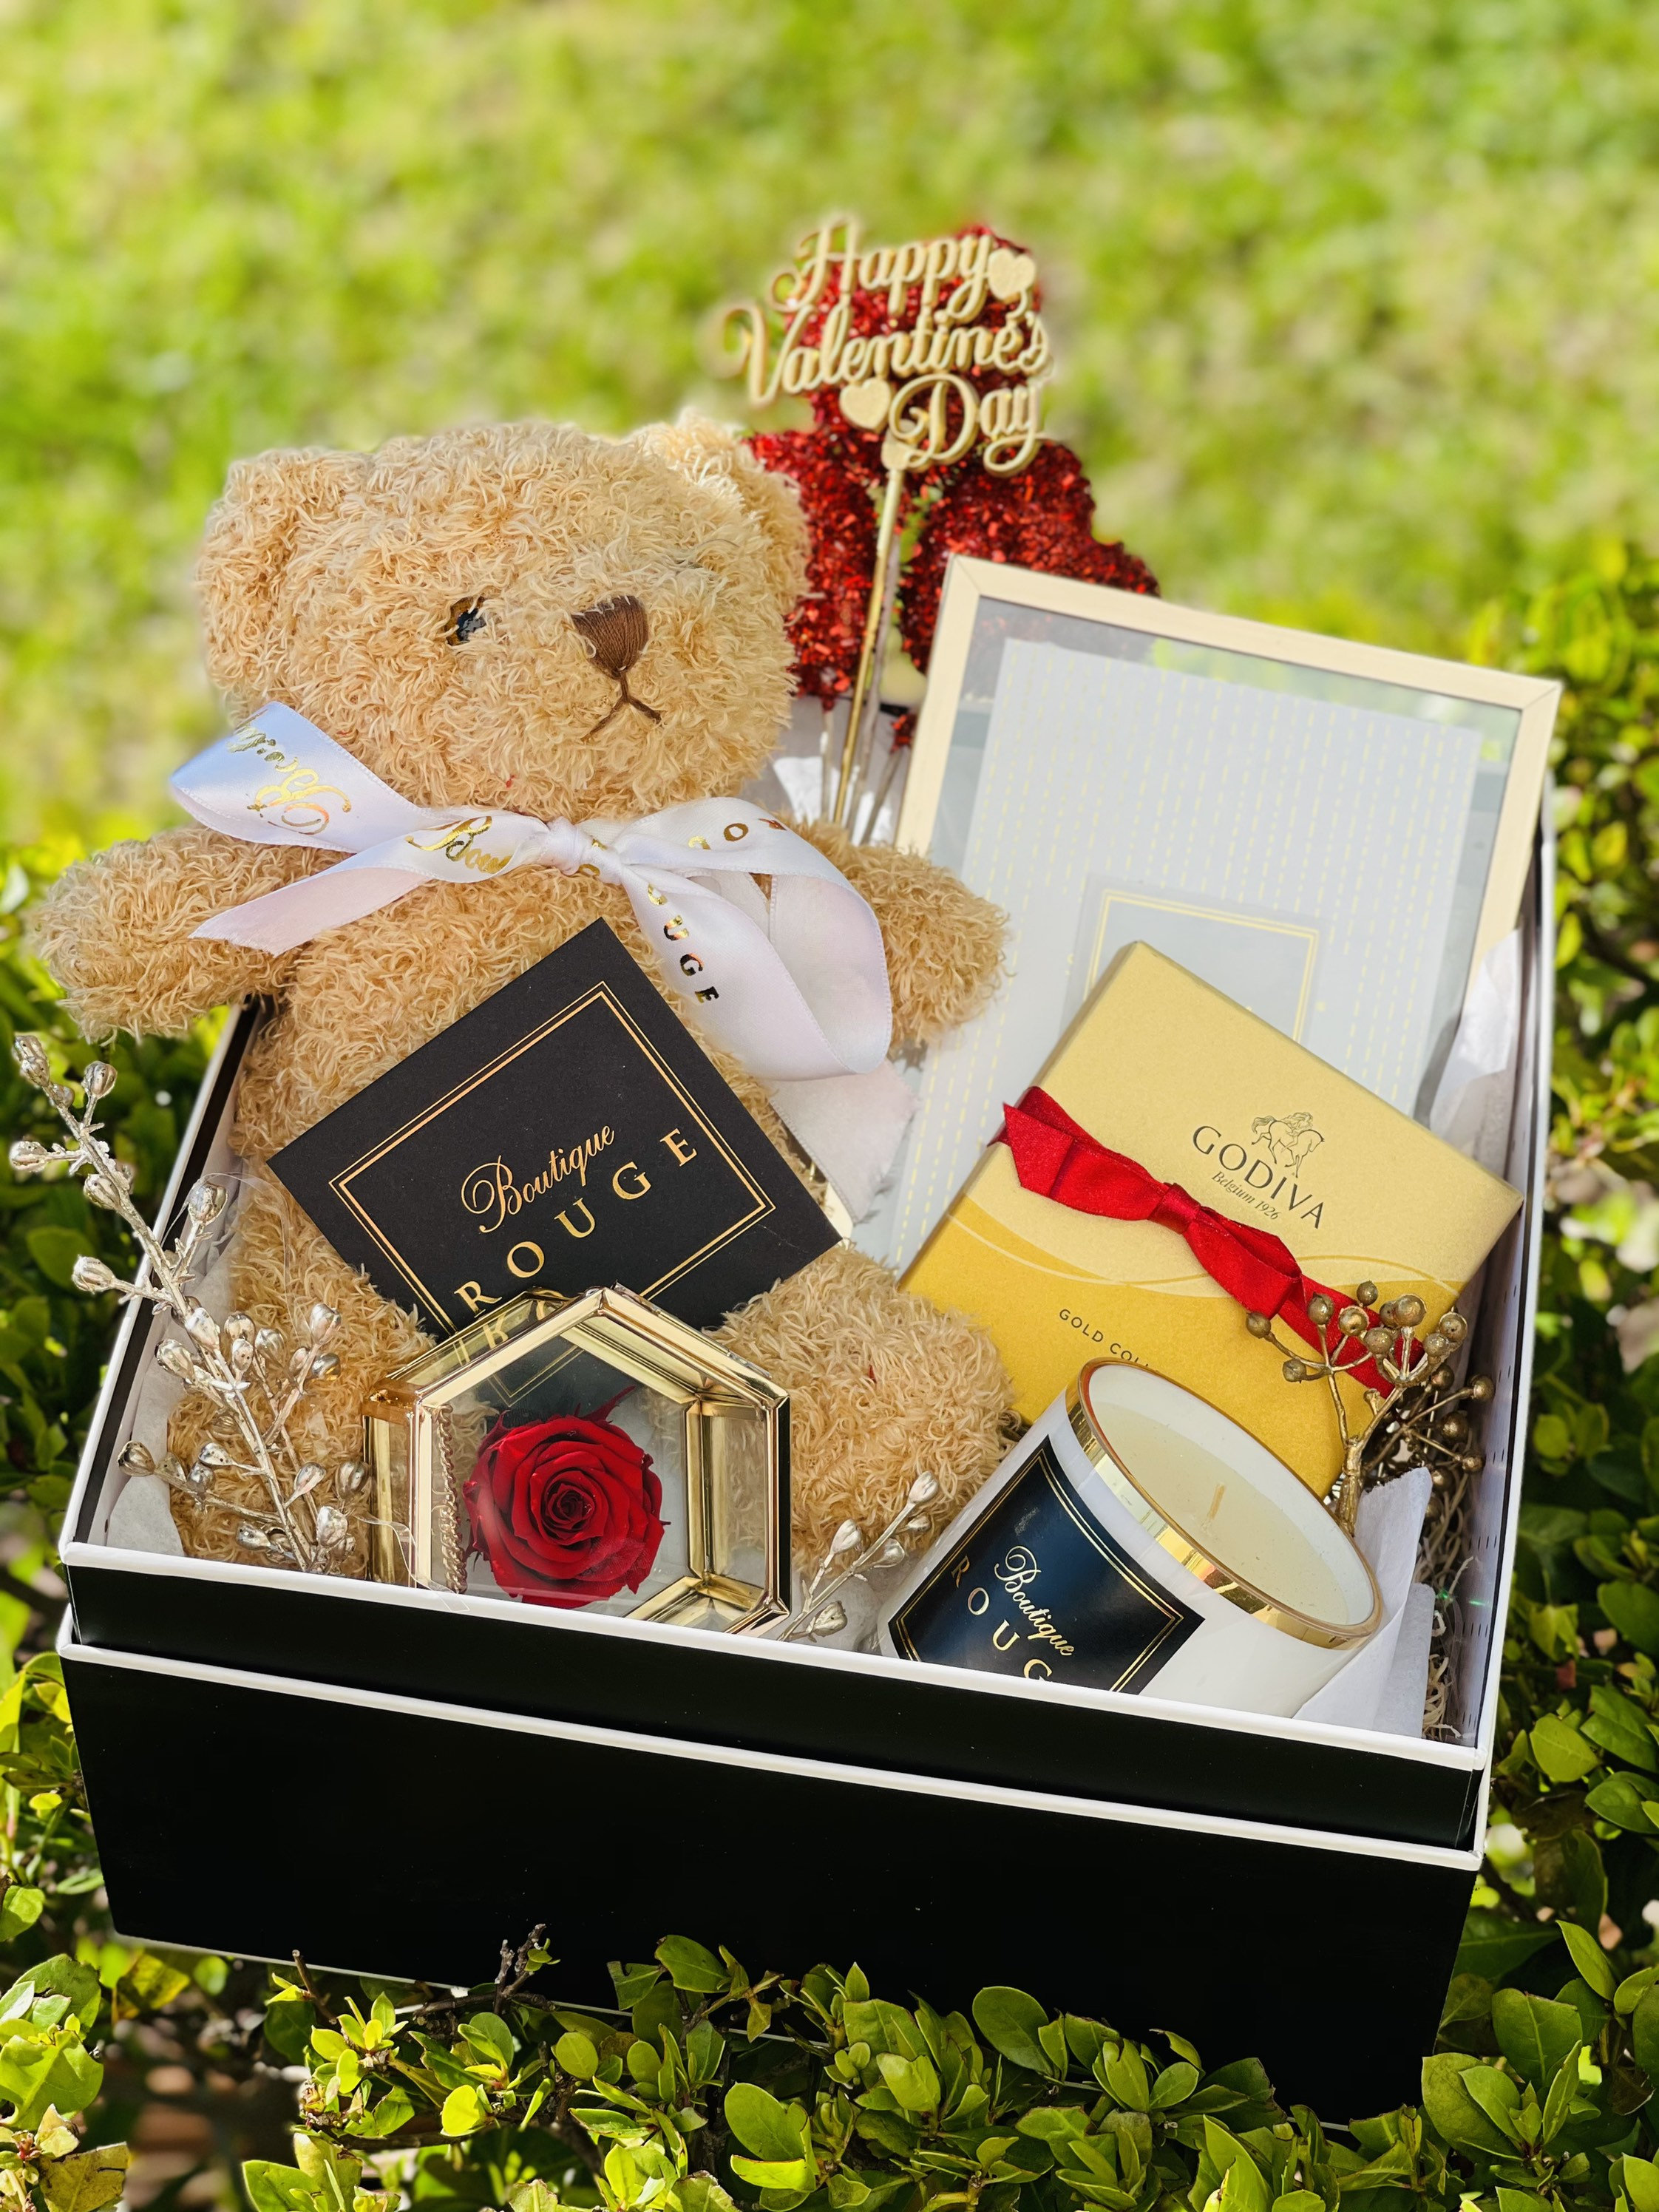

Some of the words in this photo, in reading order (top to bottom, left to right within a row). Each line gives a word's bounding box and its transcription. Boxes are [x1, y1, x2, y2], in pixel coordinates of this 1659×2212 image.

[767, 215, 994, 323] Happy
[696, 291, 1054, 407] Valentine's
[889, 373, 1045, 478] Day
[454, 1127, 697, 1318] ROUGE
[460, 1124, 615, 1233] Boutique
[1192, 1125, 1324, 1229] GODIVA
[1211, 1171, 1255, 1205] Belgium
[1255, 1200, 1281, 1221] 1926
[1059, 1309, 1104, 1343] GOLD
[993, 1545, 1076, 1656] Boutique
